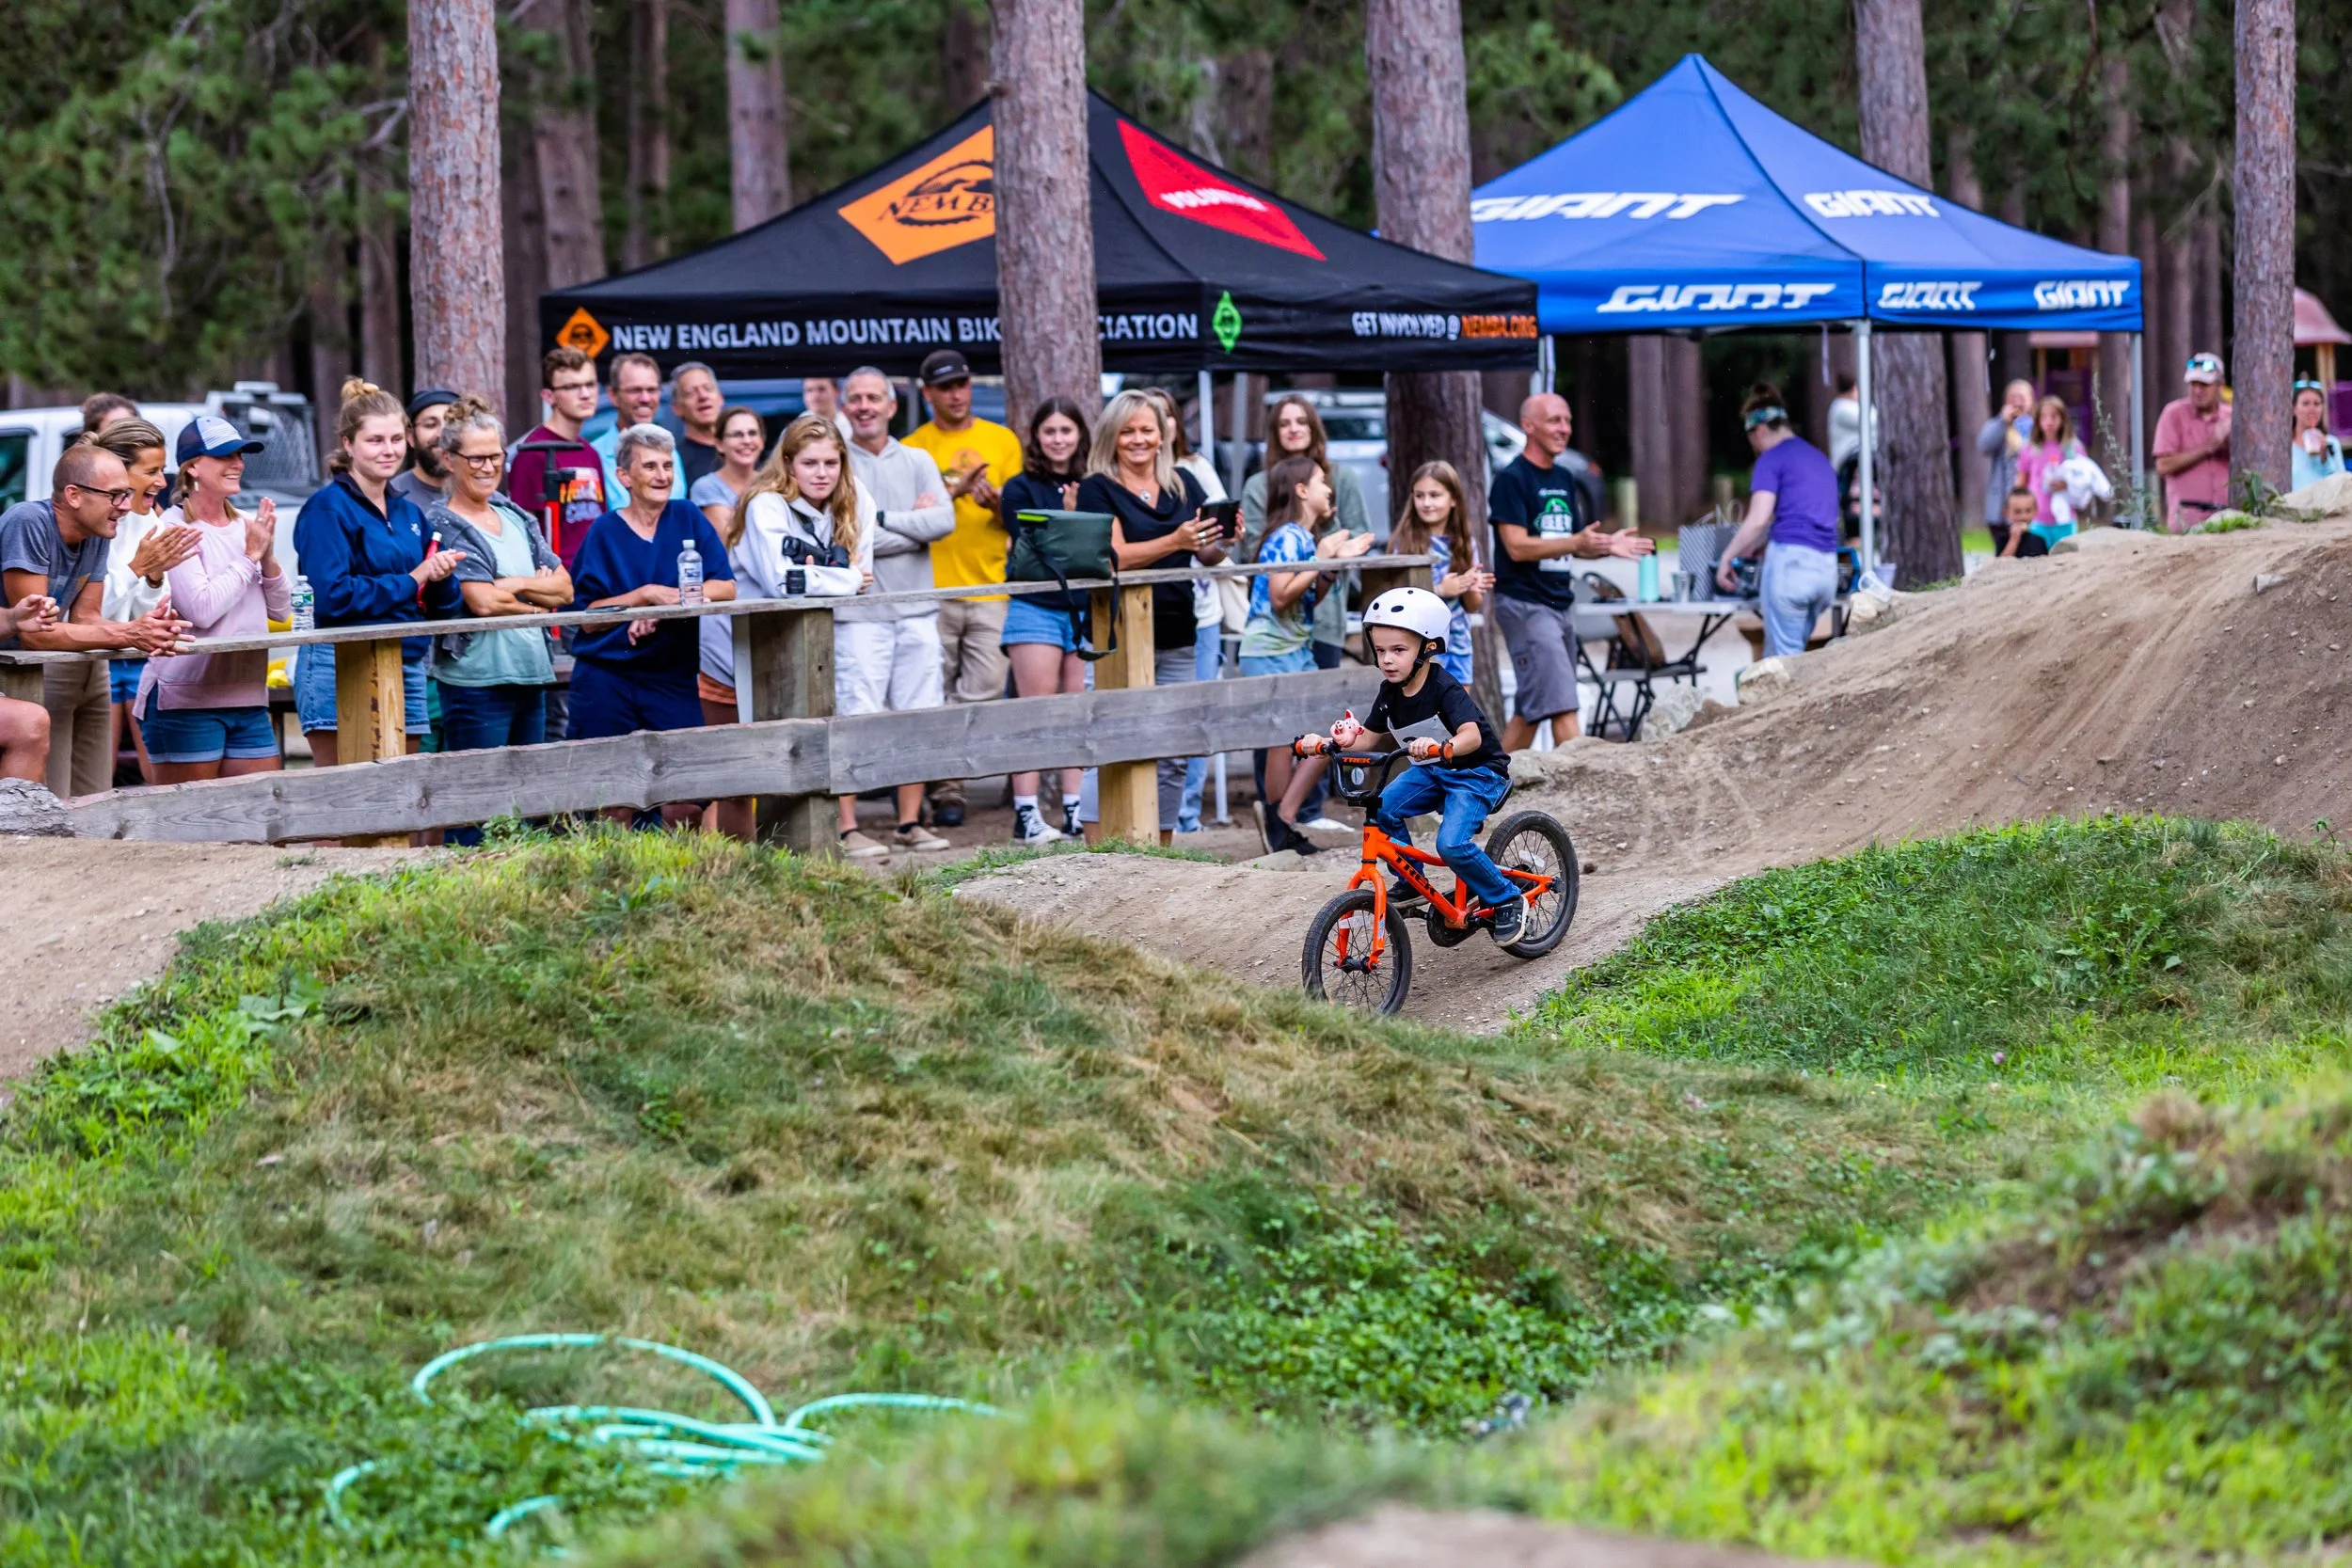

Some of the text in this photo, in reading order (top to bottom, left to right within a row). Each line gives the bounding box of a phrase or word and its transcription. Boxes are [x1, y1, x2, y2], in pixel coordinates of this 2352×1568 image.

[876, 193, 993, 221] NEMB
[1470, 192, 1746, 222] GIANT
[1804, 190, 1941, 217] GIANT
[1597, 283, 1836, 313] GIANT
[1877, 281, 1982, 309] GIANT
[2033, 280, 2130, 309] GIANT
[612, 325, 671, 350] NEW
[676, 321, 800, 349] ENGLAND
[805, 317, 952, 345] MOUNTAIN
[957, 317, 1003, 342] BIK
[1352, 311, 1377, 337] GET
[1378, 312, 1446, 339] INVOLVED
[1396, 856, 1438, 896] TREK
